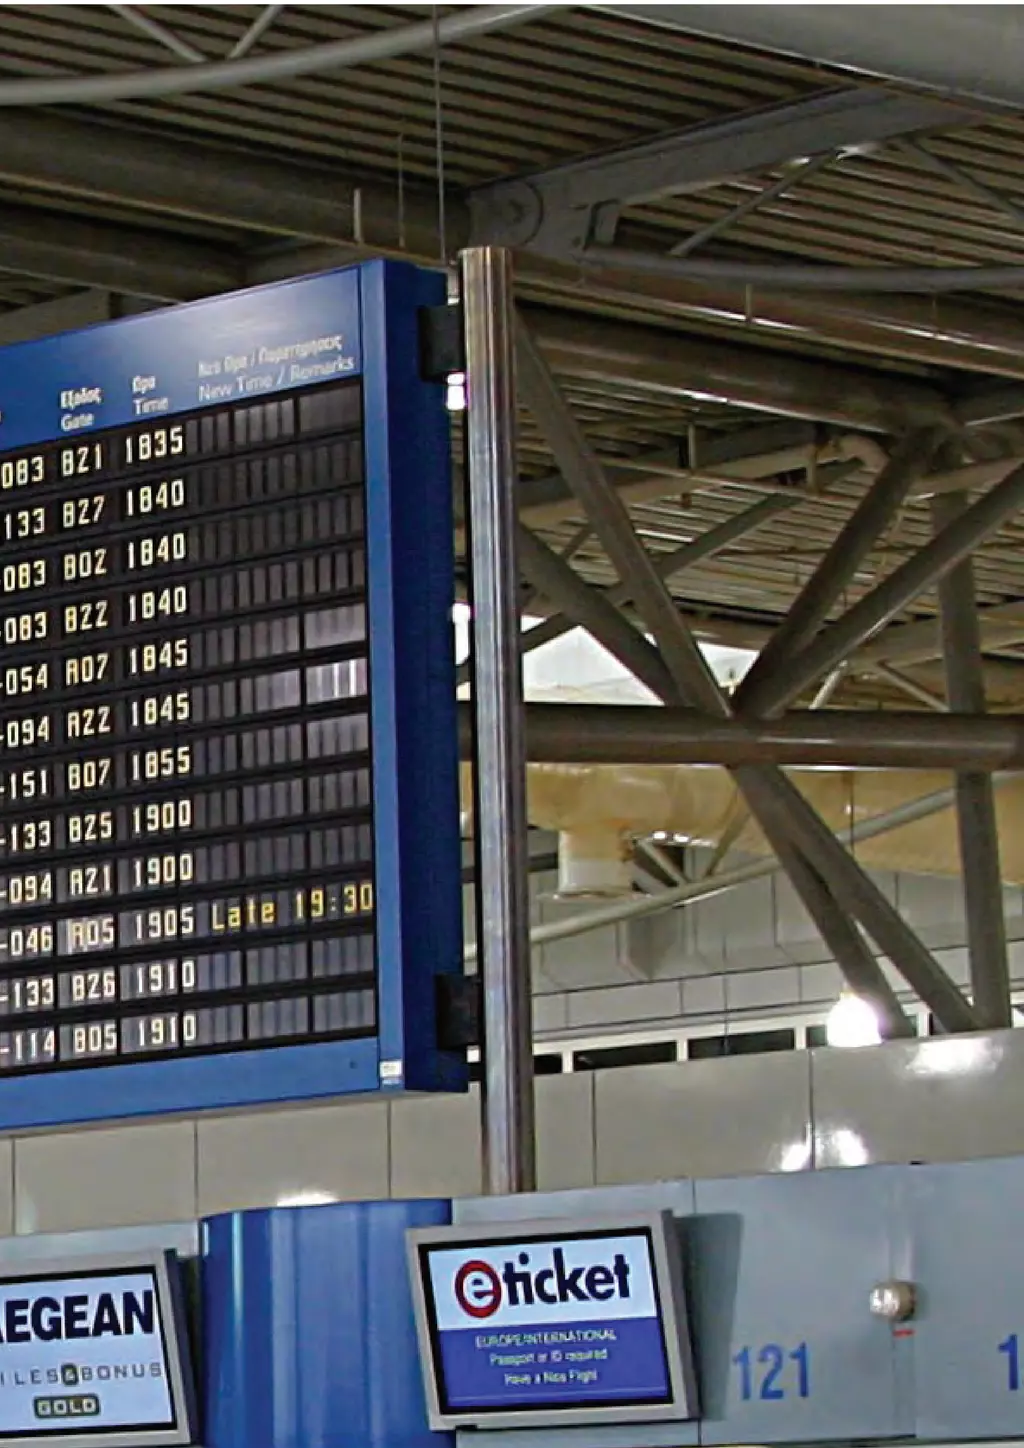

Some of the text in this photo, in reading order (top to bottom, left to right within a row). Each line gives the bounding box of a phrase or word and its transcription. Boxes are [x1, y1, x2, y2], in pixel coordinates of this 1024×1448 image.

[125, 426, 183, 463] 1835
[127, 479, 185, 516] 1840
[128, 532, 186, 569] 1840
[129, 586, 187, 622] 1840
[65, 653, 109, 686] A07
[129, 639, 188, 674] 1845
[67, 706, 111, 737] A22
[131, 692, 190, 727] 1845
[132, 746, 190, 781] 1855
[133, 799, 191, 834] 1900
[70, 864, 111, 897] A21
[134, 853, 193, 888] 1900
[136, 906, 194, 941] 1905
[212, 897, 275, 931] Late
[295, 882, 373, 920] 19:30
[136, 960, 195, 994] 1910
[138, 1013, 197, 1047] 1910
[732, 1341, 809, 1400] 121
[38, 1398, 97, 1417] GOLD
